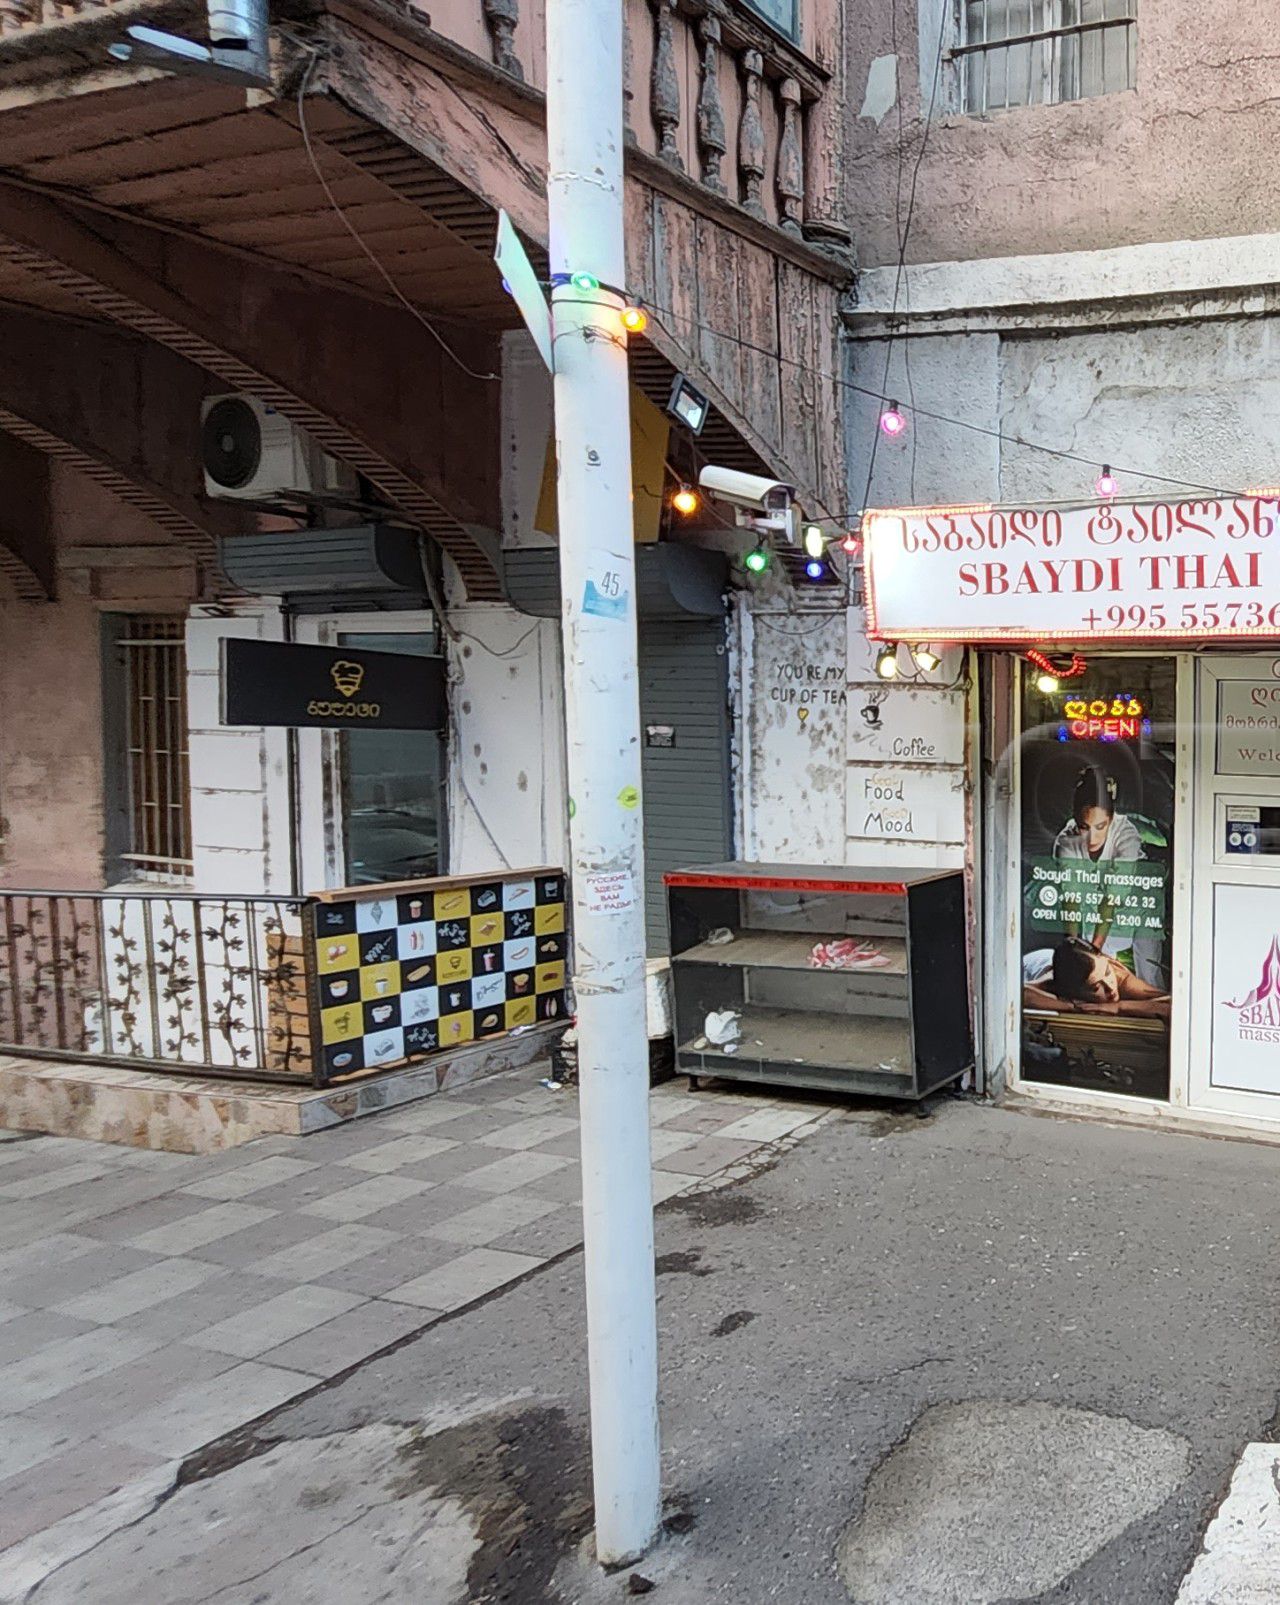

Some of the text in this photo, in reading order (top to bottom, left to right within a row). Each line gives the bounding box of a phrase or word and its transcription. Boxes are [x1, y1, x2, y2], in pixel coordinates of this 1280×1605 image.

[900, 508, 1062, 553] საბაიდი
[601, 571, 620, 596] 45
[959, 557, 1123, 597] SBAYDI
[1139, 551, 1264, 591] THAI
[1081, 604, 1166, 630] +995
[776, 661, 845, 681] YOU'RE MY
[771, 687, 847, 705] CUP OF TEA
[1071, 718, 1136, 737] OPEN
[893, 737, 936, 758] Coffee
[864, 778, 904, 801] Food
[863, 811, 914, 834] Mood
[1033, 866, 1163, 890] Sbaydi Thai massages
[1085, 892, 1104, 905] 557
[1107, 894, 1121, 906] 24
[1125, 896, 1138, 908] 62
[1142, 897, 1156, 909] 32
[1032, 908, 1057, 920] OPEN
[1116, 914, 1141, 927] 12:00
